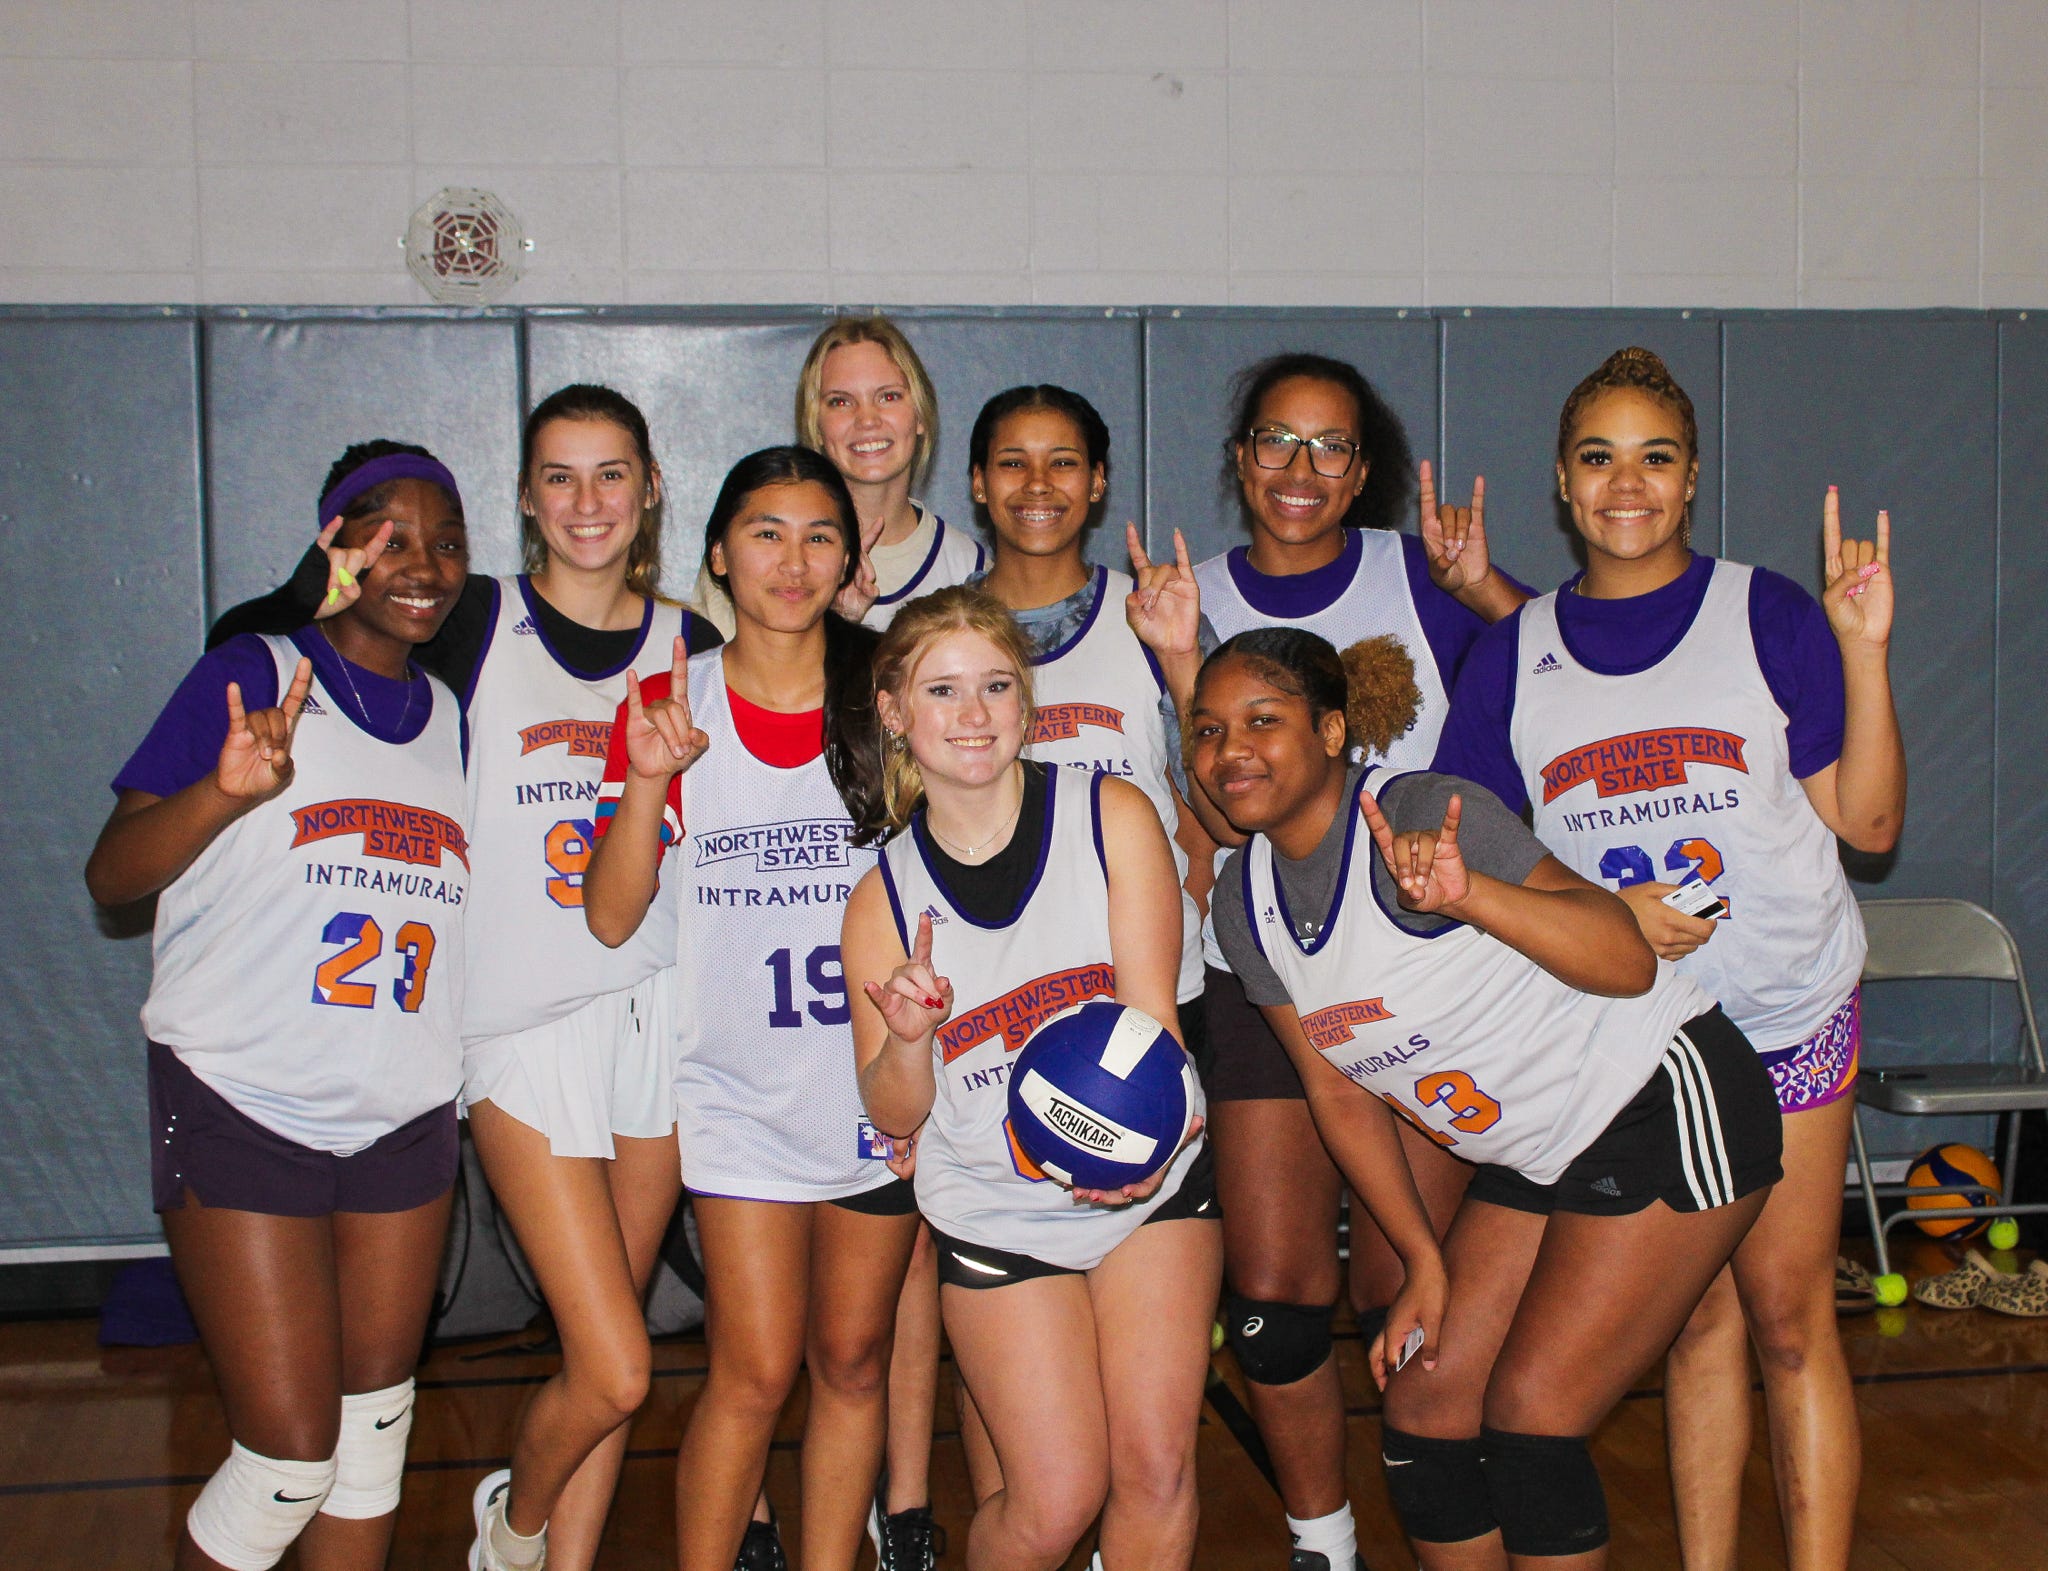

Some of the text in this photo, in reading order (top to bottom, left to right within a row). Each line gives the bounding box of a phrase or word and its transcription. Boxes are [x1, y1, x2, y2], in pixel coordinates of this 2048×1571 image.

[1532, 663, 1563, 675] adidas
[526, 723, 613, 747] NORTHWE
[573, 738, 609, 757] STA
[1545, 733, 1742, 794] NORTHWESTERN
[1601, 759, 1680, 791] STATE
[516, 780, 602, 805] INTRAM
[1563, 788, 1740, 832] INTRAMURALS
[369, 829, 436, 860] STATE
[704, 823, 855, 858] NORTHWEST
[763, 844, 840, 867] STATE
[544, 818, 597, 908] 9
[305, 863, 464, 906] INTRAMURALS
[698, 883, 852, 907] INTRAMUR
[310, 911, 437, 1014] 23
[764, 944, 852, 1028] 19
[942, 968, 1117, 1054] NORTHWESTERN
[1302, 1002, 1383, 1035] THWESTERN
[1312, 1023, 1350, 1047] STATE
[1340, 1033, 1431, 1079] AMURALS
[1046, 1096, 1116, 1149] TACHIKARA
[1590, 1183, 1622, 1197] adidas
